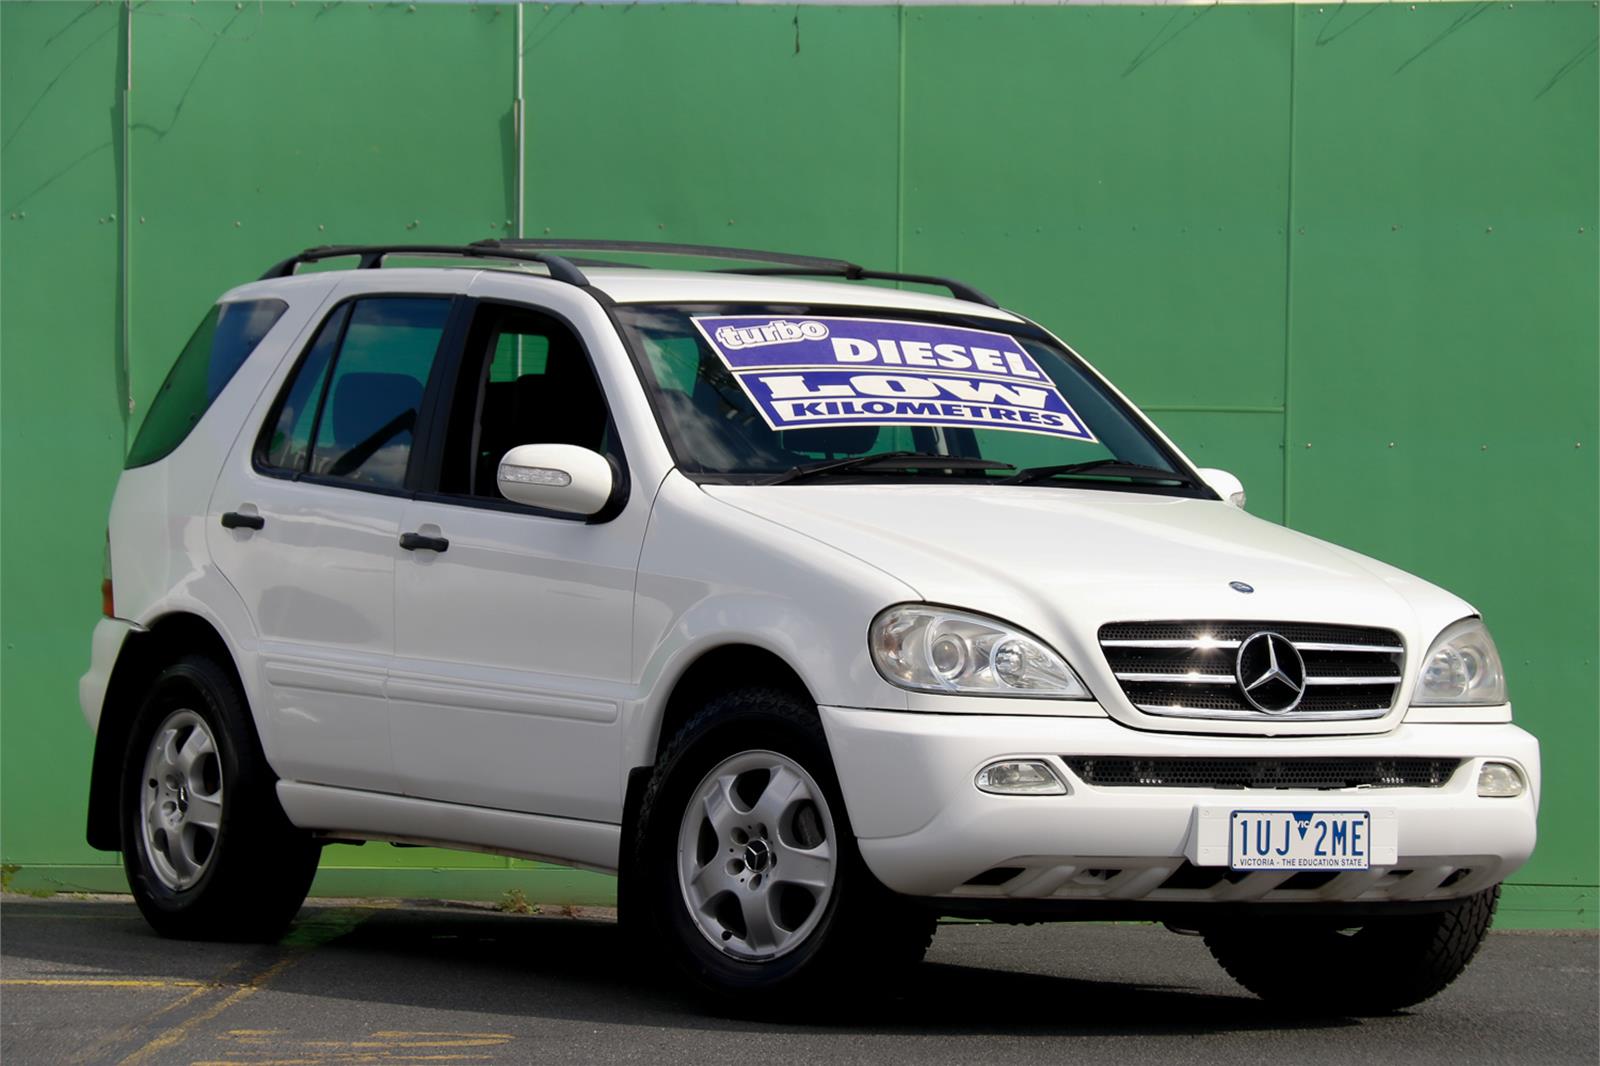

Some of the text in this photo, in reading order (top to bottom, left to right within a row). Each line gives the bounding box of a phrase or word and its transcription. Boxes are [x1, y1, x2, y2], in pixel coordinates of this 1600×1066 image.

[715, 320, 829, 350] turbo
[831, 337, 1040, 379] DIESEL
[759, 374, 1057, 409] LOW
[792, 401, 1064, 427] KILOMETRES
[1240, 820, 1364, 856] 1UJ 2ME
